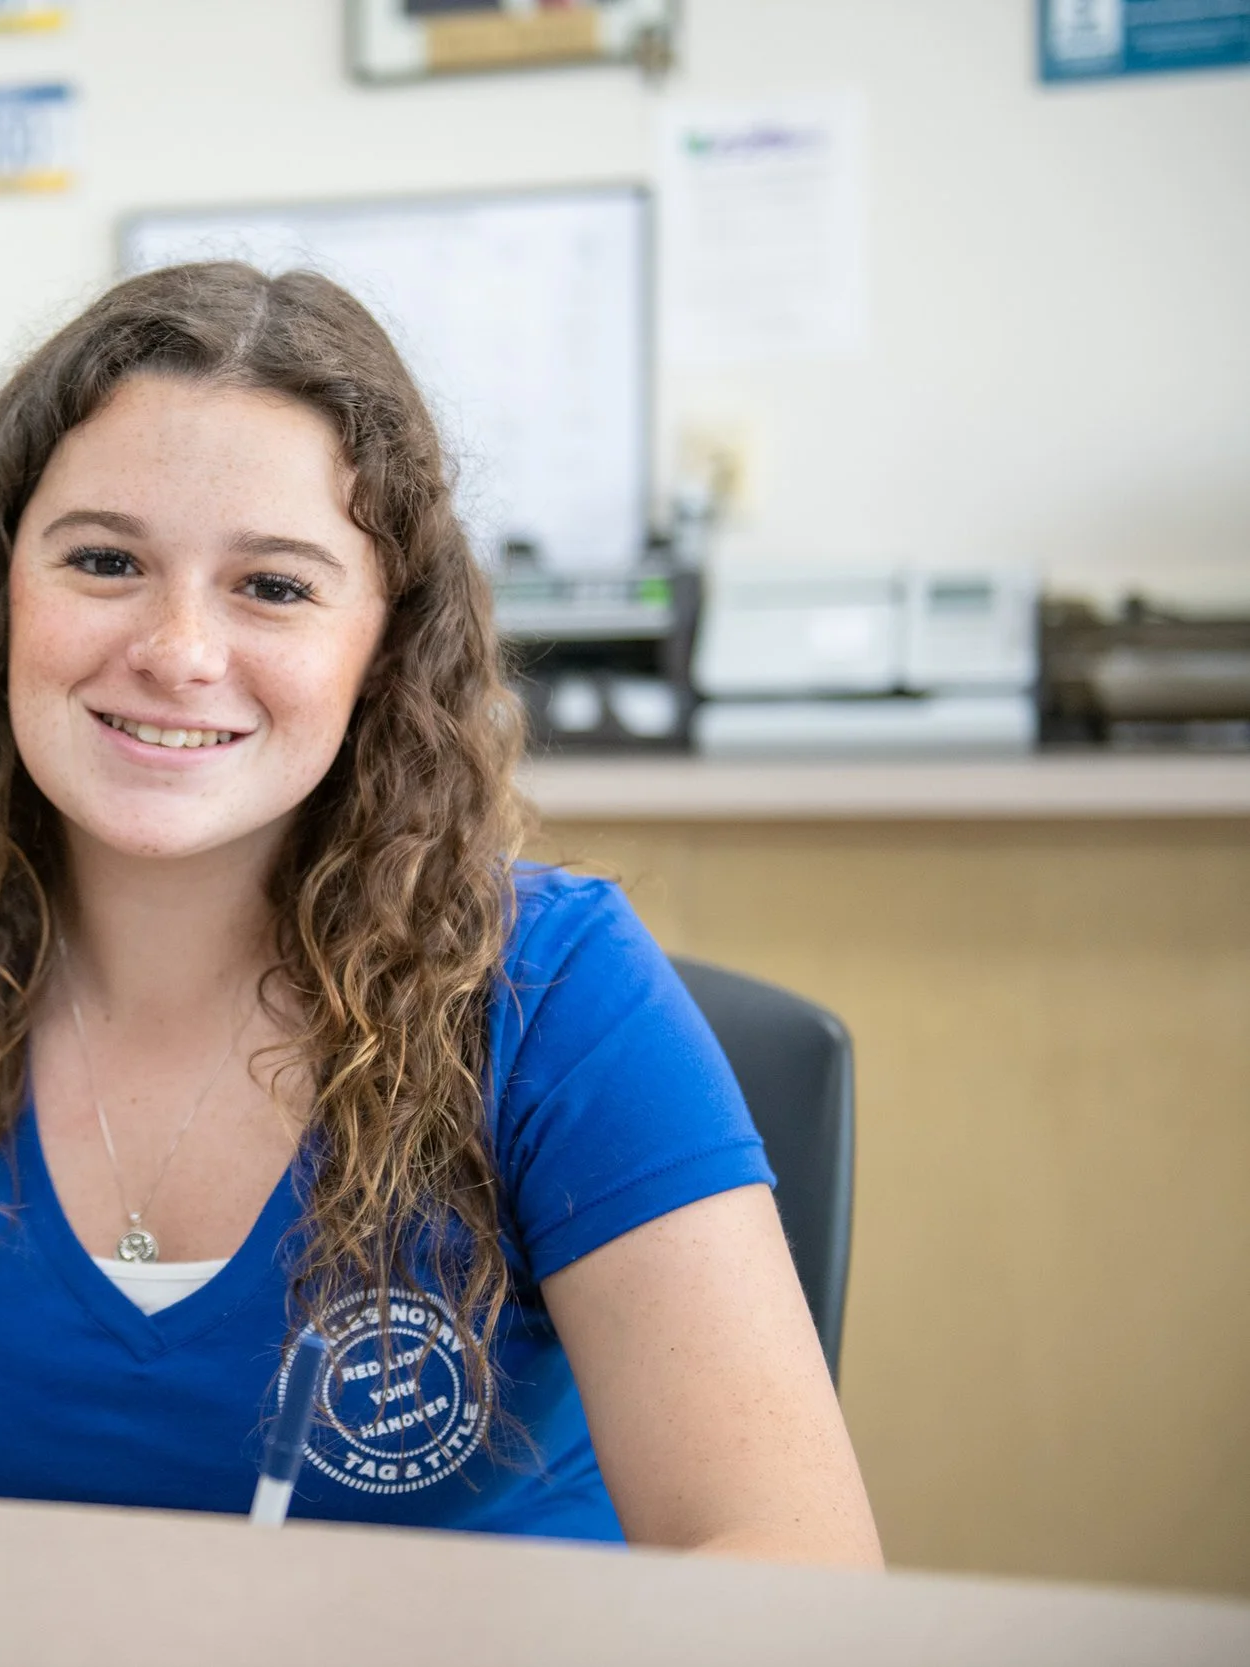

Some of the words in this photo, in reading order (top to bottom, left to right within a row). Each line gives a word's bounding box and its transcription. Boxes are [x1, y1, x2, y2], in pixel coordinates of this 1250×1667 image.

[342, 1361, 381, 1382] RED
[369, 1379, 421, 1405] YORK
[360, 1395, 450, 1439] HANOVER
[344, 1452, 398, 1480] TAG
[405, 1462, 421, 1479] &
[424, 1402, 479, 1468] TITLE
